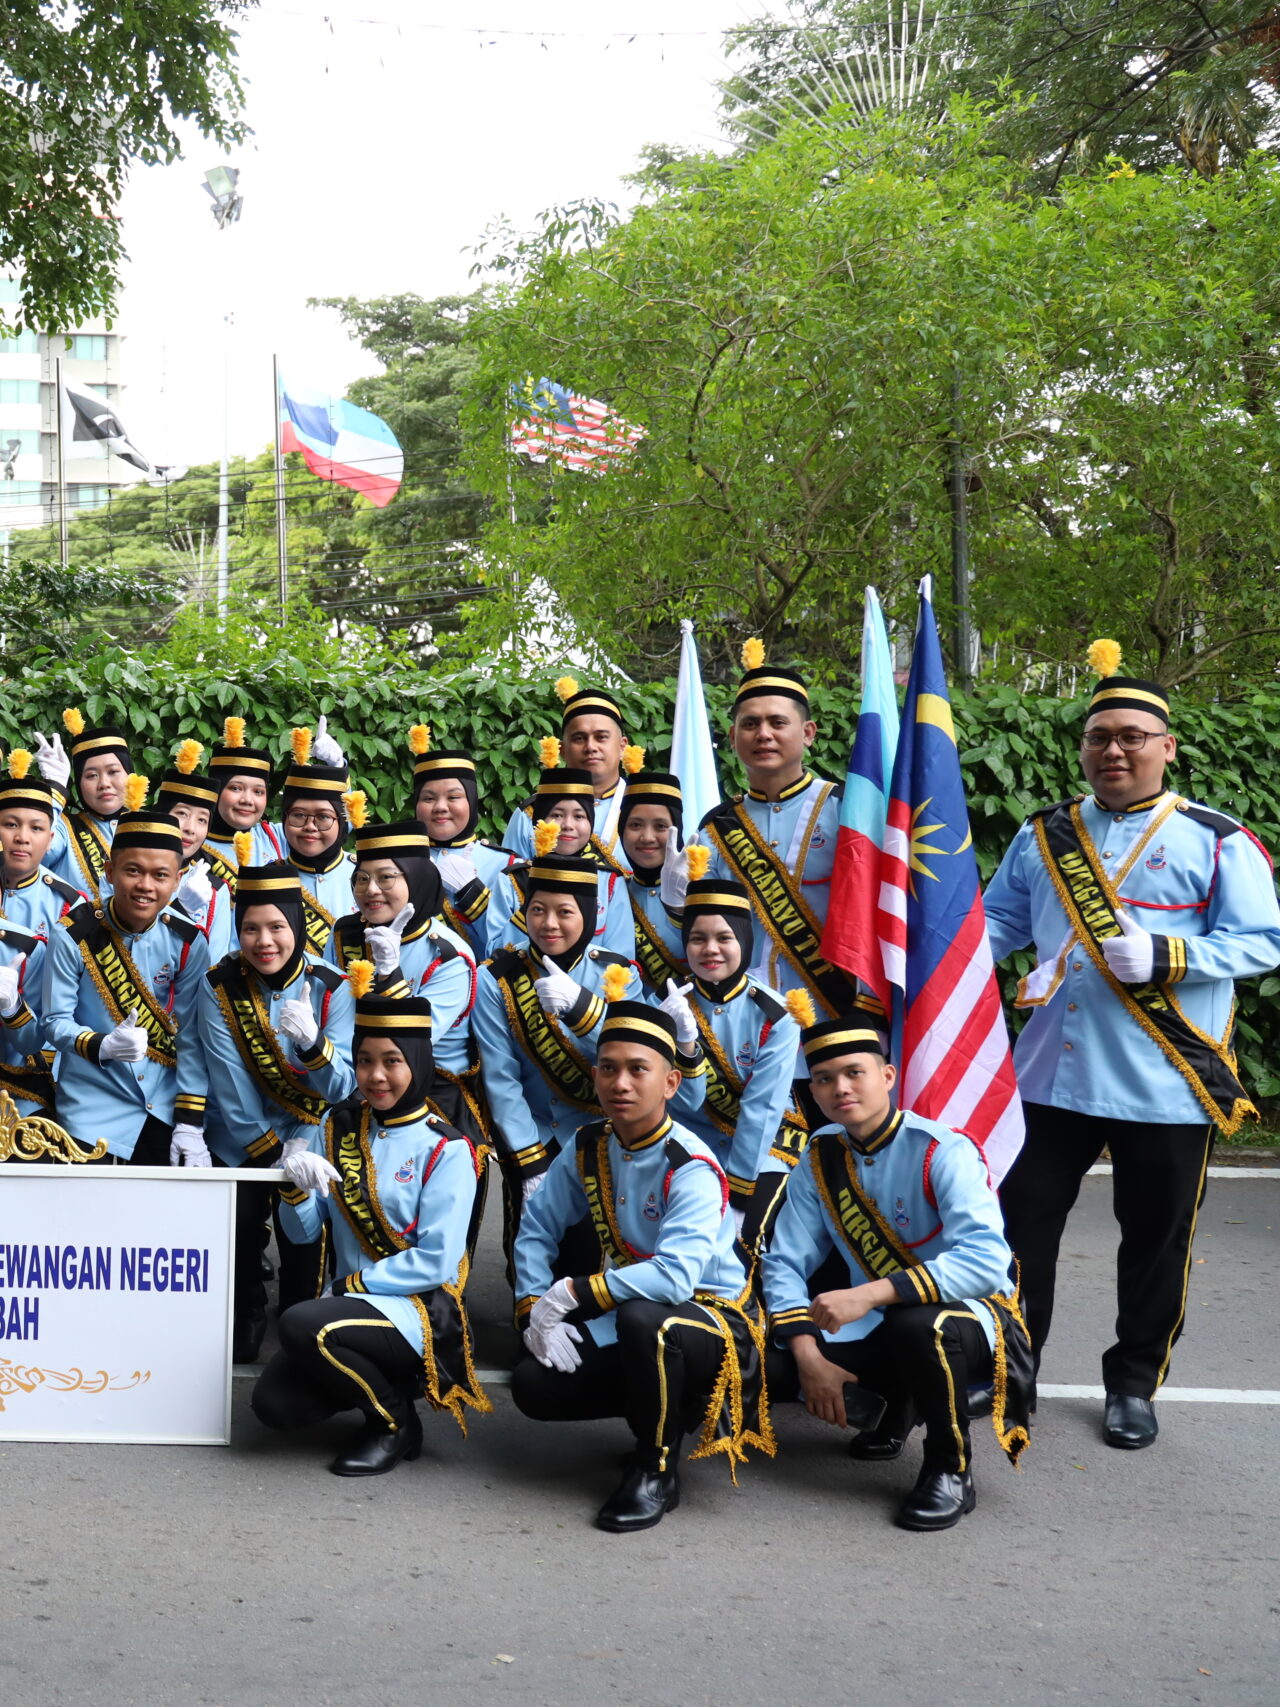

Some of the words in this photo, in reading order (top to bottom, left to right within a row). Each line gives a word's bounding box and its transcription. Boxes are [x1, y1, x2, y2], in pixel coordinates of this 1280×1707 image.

[724, 828, 806, 936] DIRGAHAYU
[1059, 850, 1122, 943] DIRGAHA
[120, 1247, 208, 1292] NEGERI
[839, 1188, 903, 1278] DIRGAH
